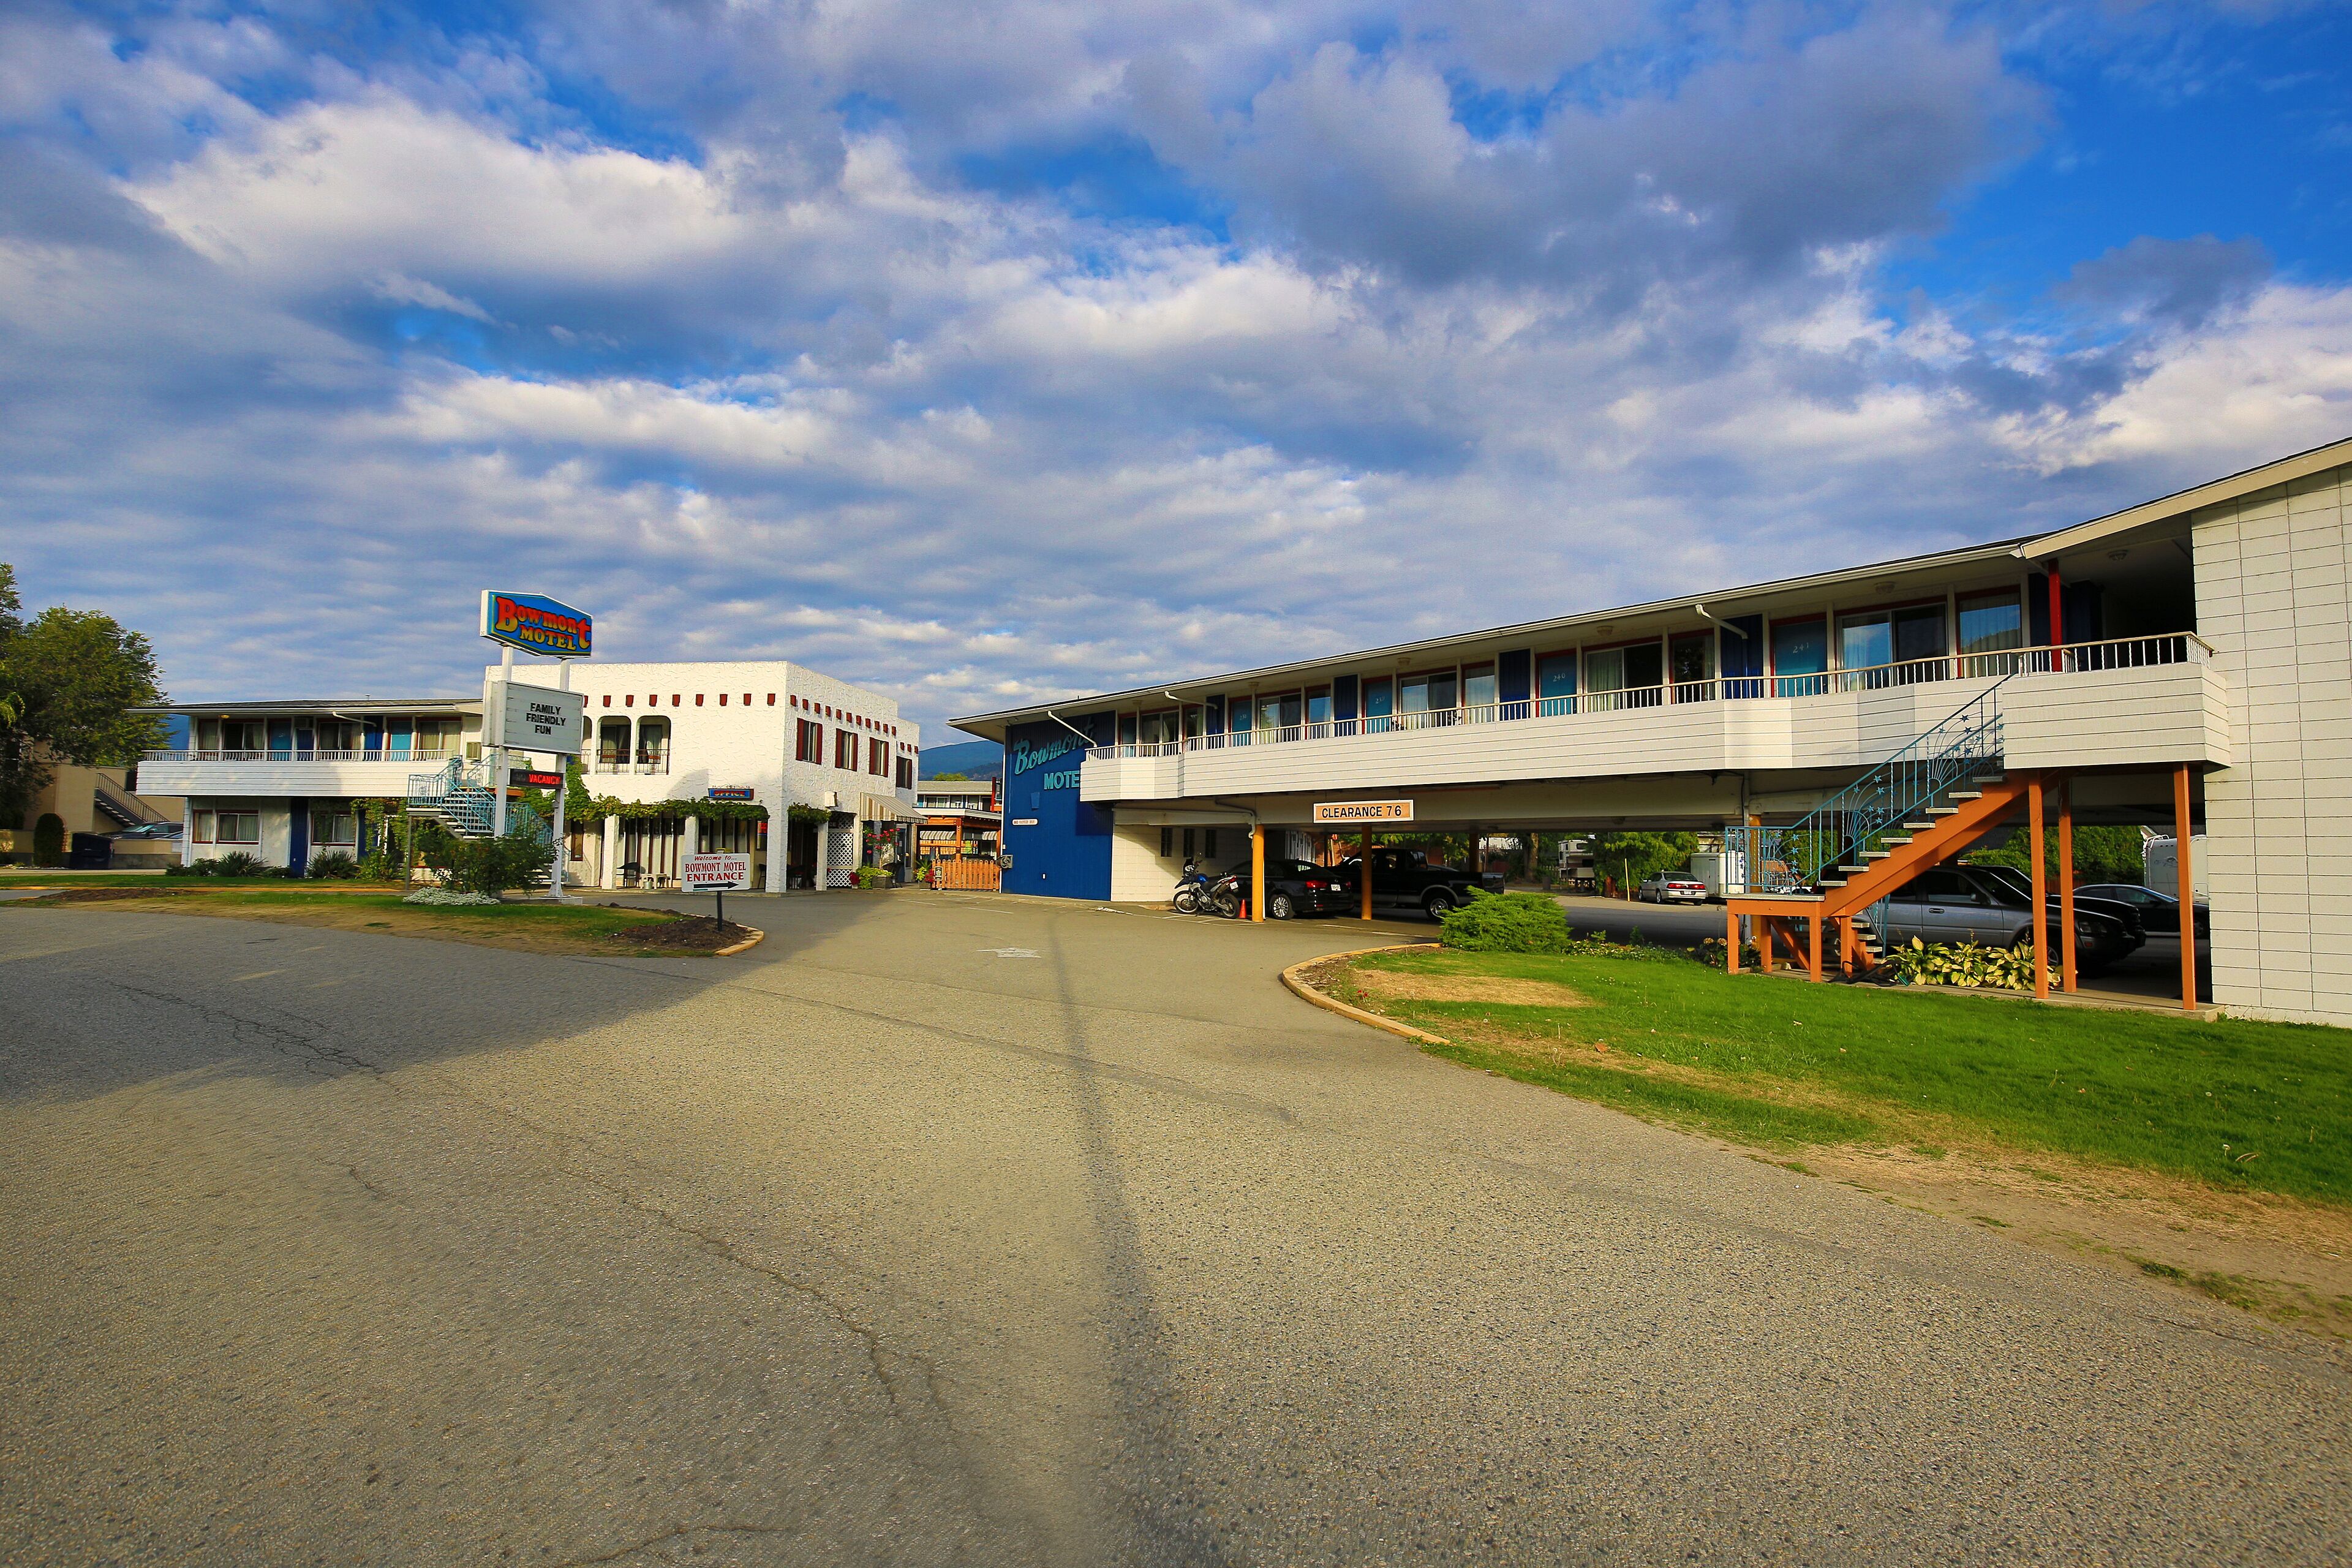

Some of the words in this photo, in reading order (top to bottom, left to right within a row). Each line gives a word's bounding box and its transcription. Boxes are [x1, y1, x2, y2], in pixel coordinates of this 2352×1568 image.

[495, 597, 591, 649] Bowmont
[519, 625, 576, 650] MOTEL
[530, 703, 561, 715] FAMILY
[526, 712, 566, 726] FRIENDLY
[535, 725, 551, 735] FUN
[529, 774, 561, 785] VACANCY
[1044, 770, 1080, 790] MOTE
[1322, 806, 1382, 818] CLEARANCE
[685, 862, 721, 873] BOWMONT
[724, 862, 746, 872] MOTEL
[687, 872, 744, 882] ENTRANCE
